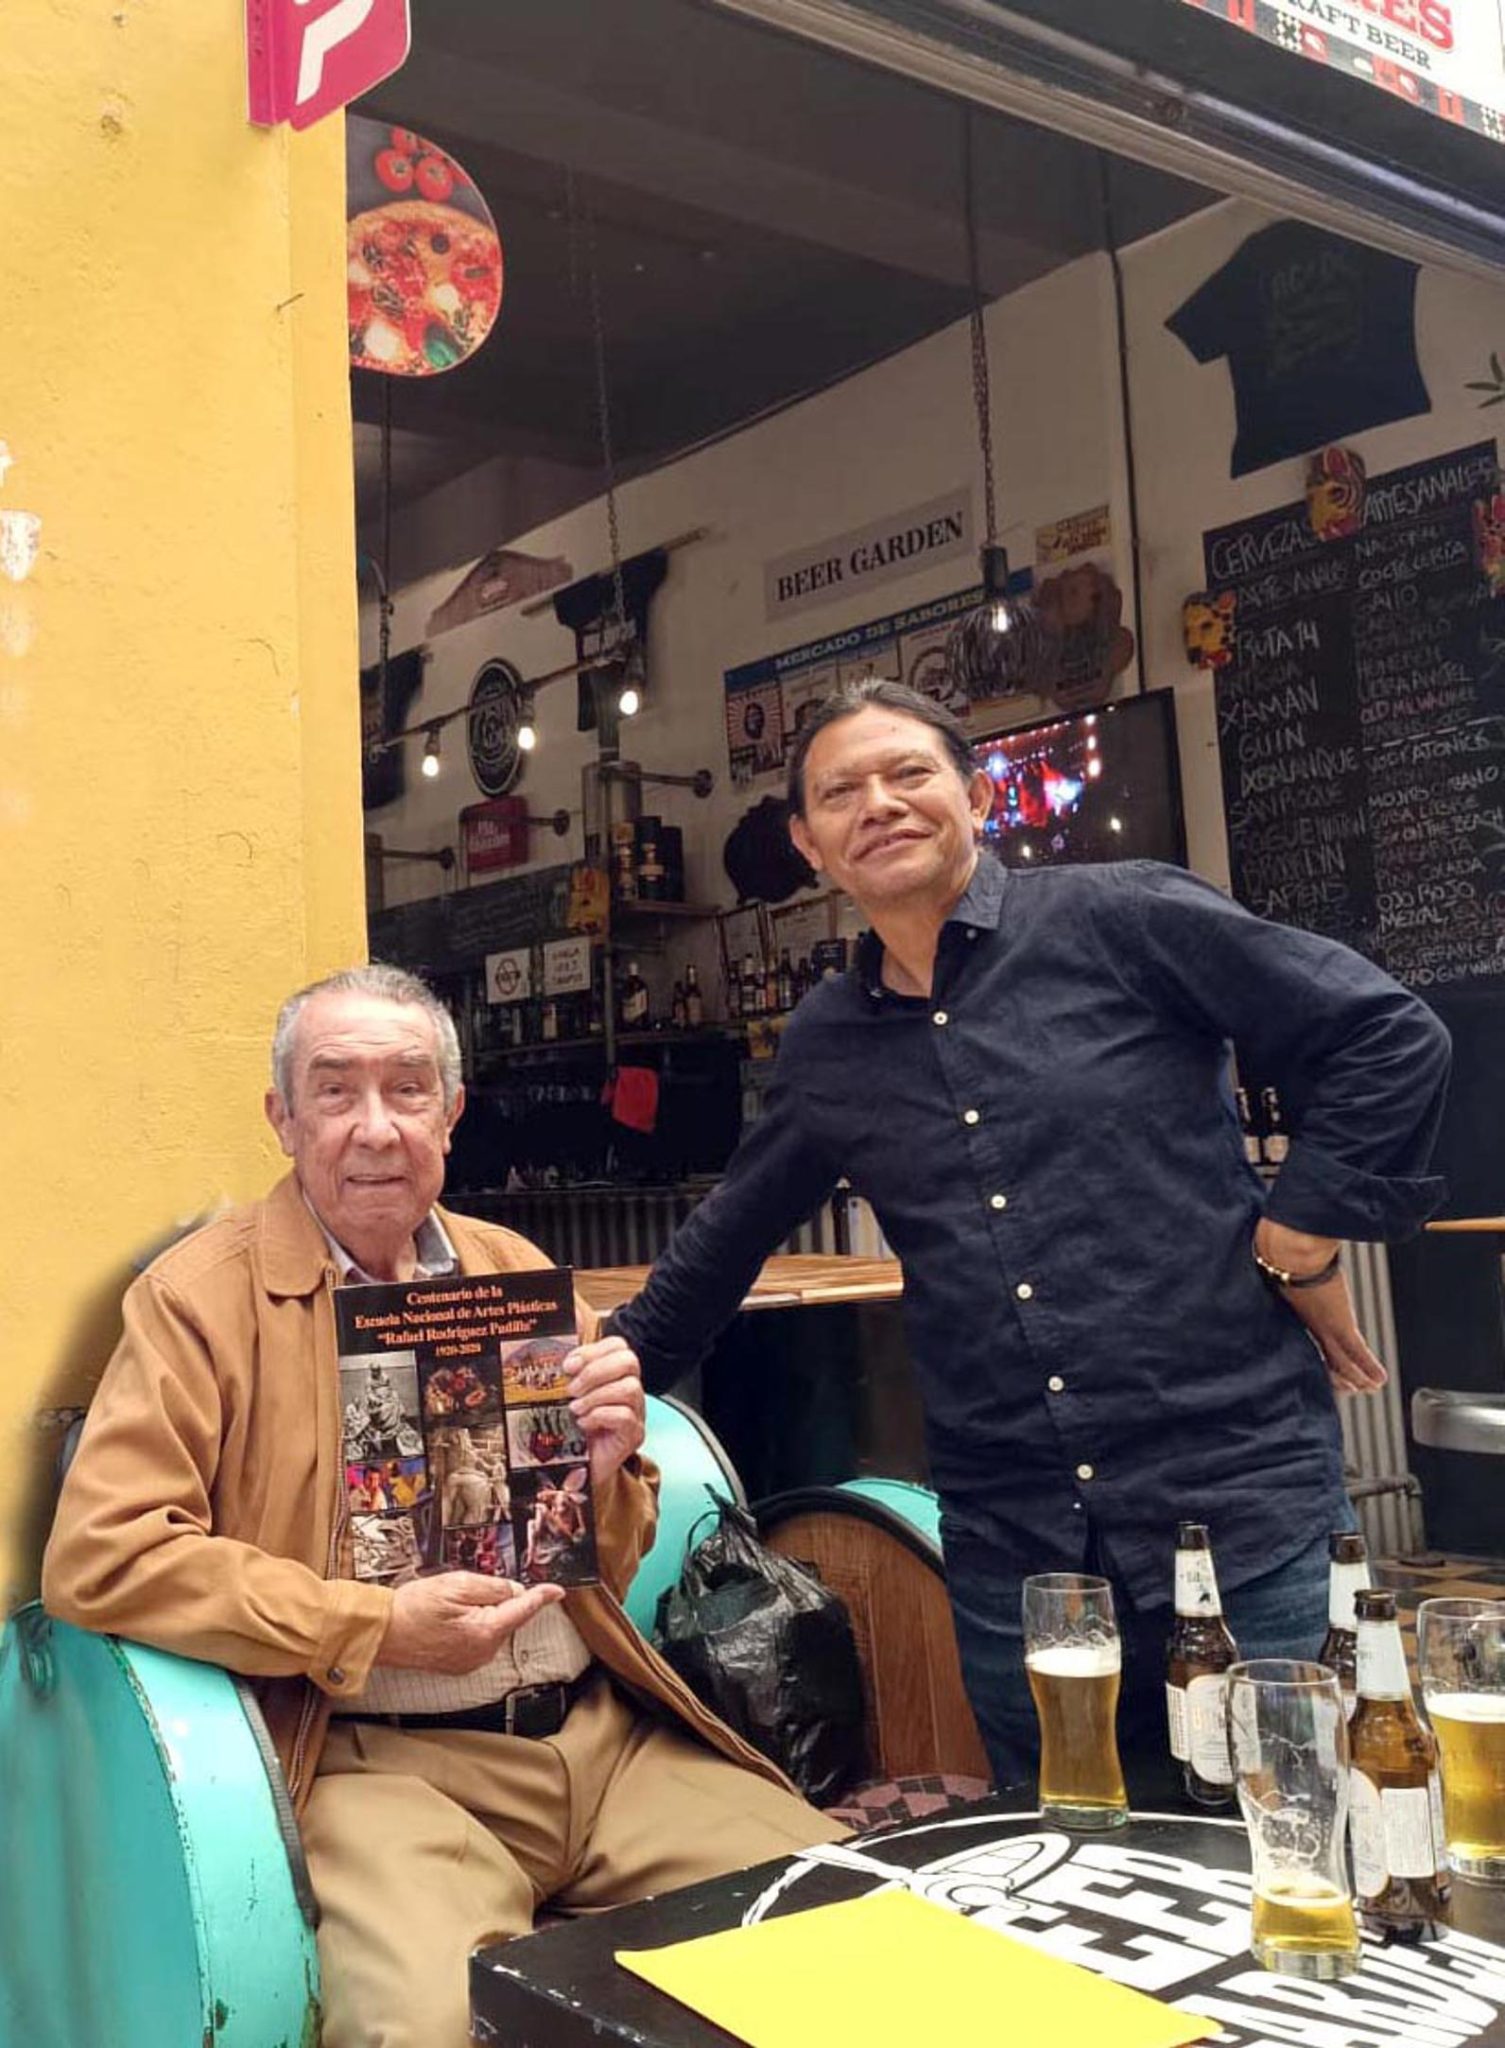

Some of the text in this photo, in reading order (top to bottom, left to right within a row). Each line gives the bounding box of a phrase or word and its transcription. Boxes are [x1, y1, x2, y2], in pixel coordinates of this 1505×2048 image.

[1366, 23, 1432, 70] BEER
[777, 511, 964, 602] BEER GARDEN
[775, 632, 861, 669] MERCADO
[865, 621, 891, 640] DE
[355, 1314, 401, 1329] Escuela
[402, 1309, 455, 1325] Nacional
[456, 1306, 472, 1320] de
[473, 1304, 505, 1319] Artes
[406, 1285, 503, 1306] Centenario de la
